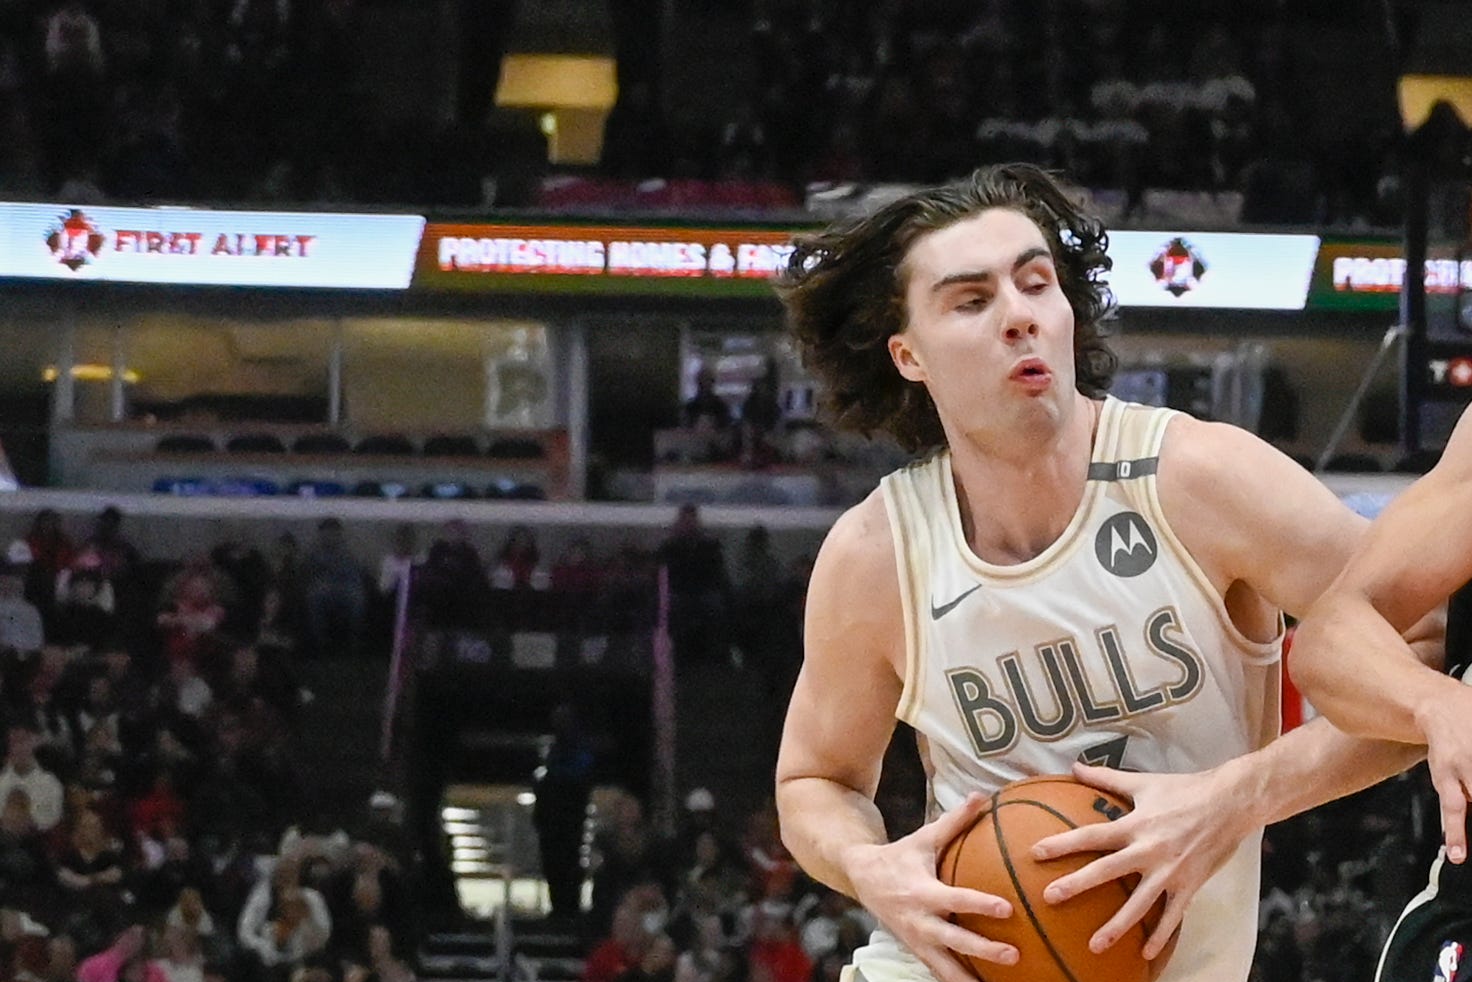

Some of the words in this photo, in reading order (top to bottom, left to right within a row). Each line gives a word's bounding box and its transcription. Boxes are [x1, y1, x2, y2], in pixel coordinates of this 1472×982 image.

[113, 229, 202, 255] FIRST
[211, 232, 317, 257] ALERT
[944, 604, 1206, 760] BULLS
